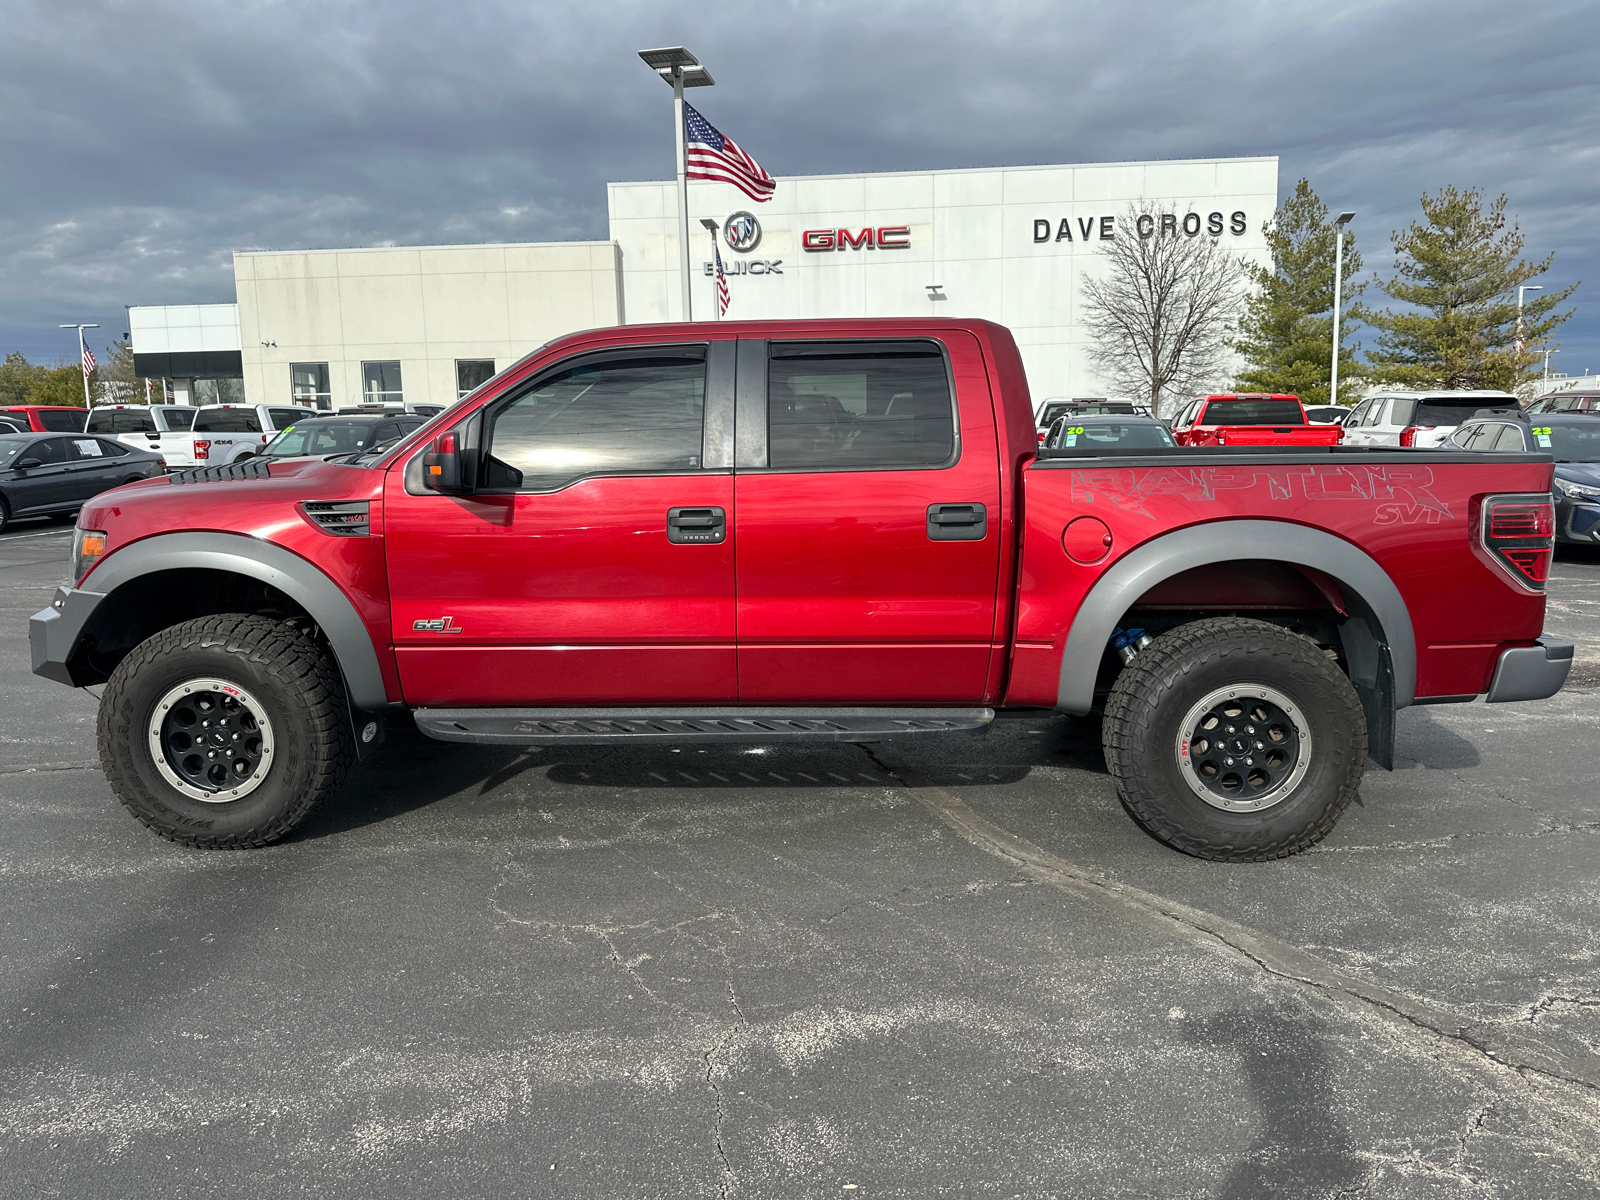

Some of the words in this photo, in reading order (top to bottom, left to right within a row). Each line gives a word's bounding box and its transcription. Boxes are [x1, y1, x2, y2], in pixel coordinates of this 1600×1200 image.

[1033, 216, 1115, 243] DAVE
[1136, 210, 1247, 240] CROSS
[802, 225, 911, 251] GMC
[1067, 426, 1084, 435] 20
[1531, 426, 1552, 436] 23
[1071, 466, 1454, 519] RAPTOR
[346, 514, 367, 522] SVT
[1373, 503, 1448, 525] SVT
[222, 686, 240, 696] SVT
[118, 741, 216, 831] WILDPEAK
